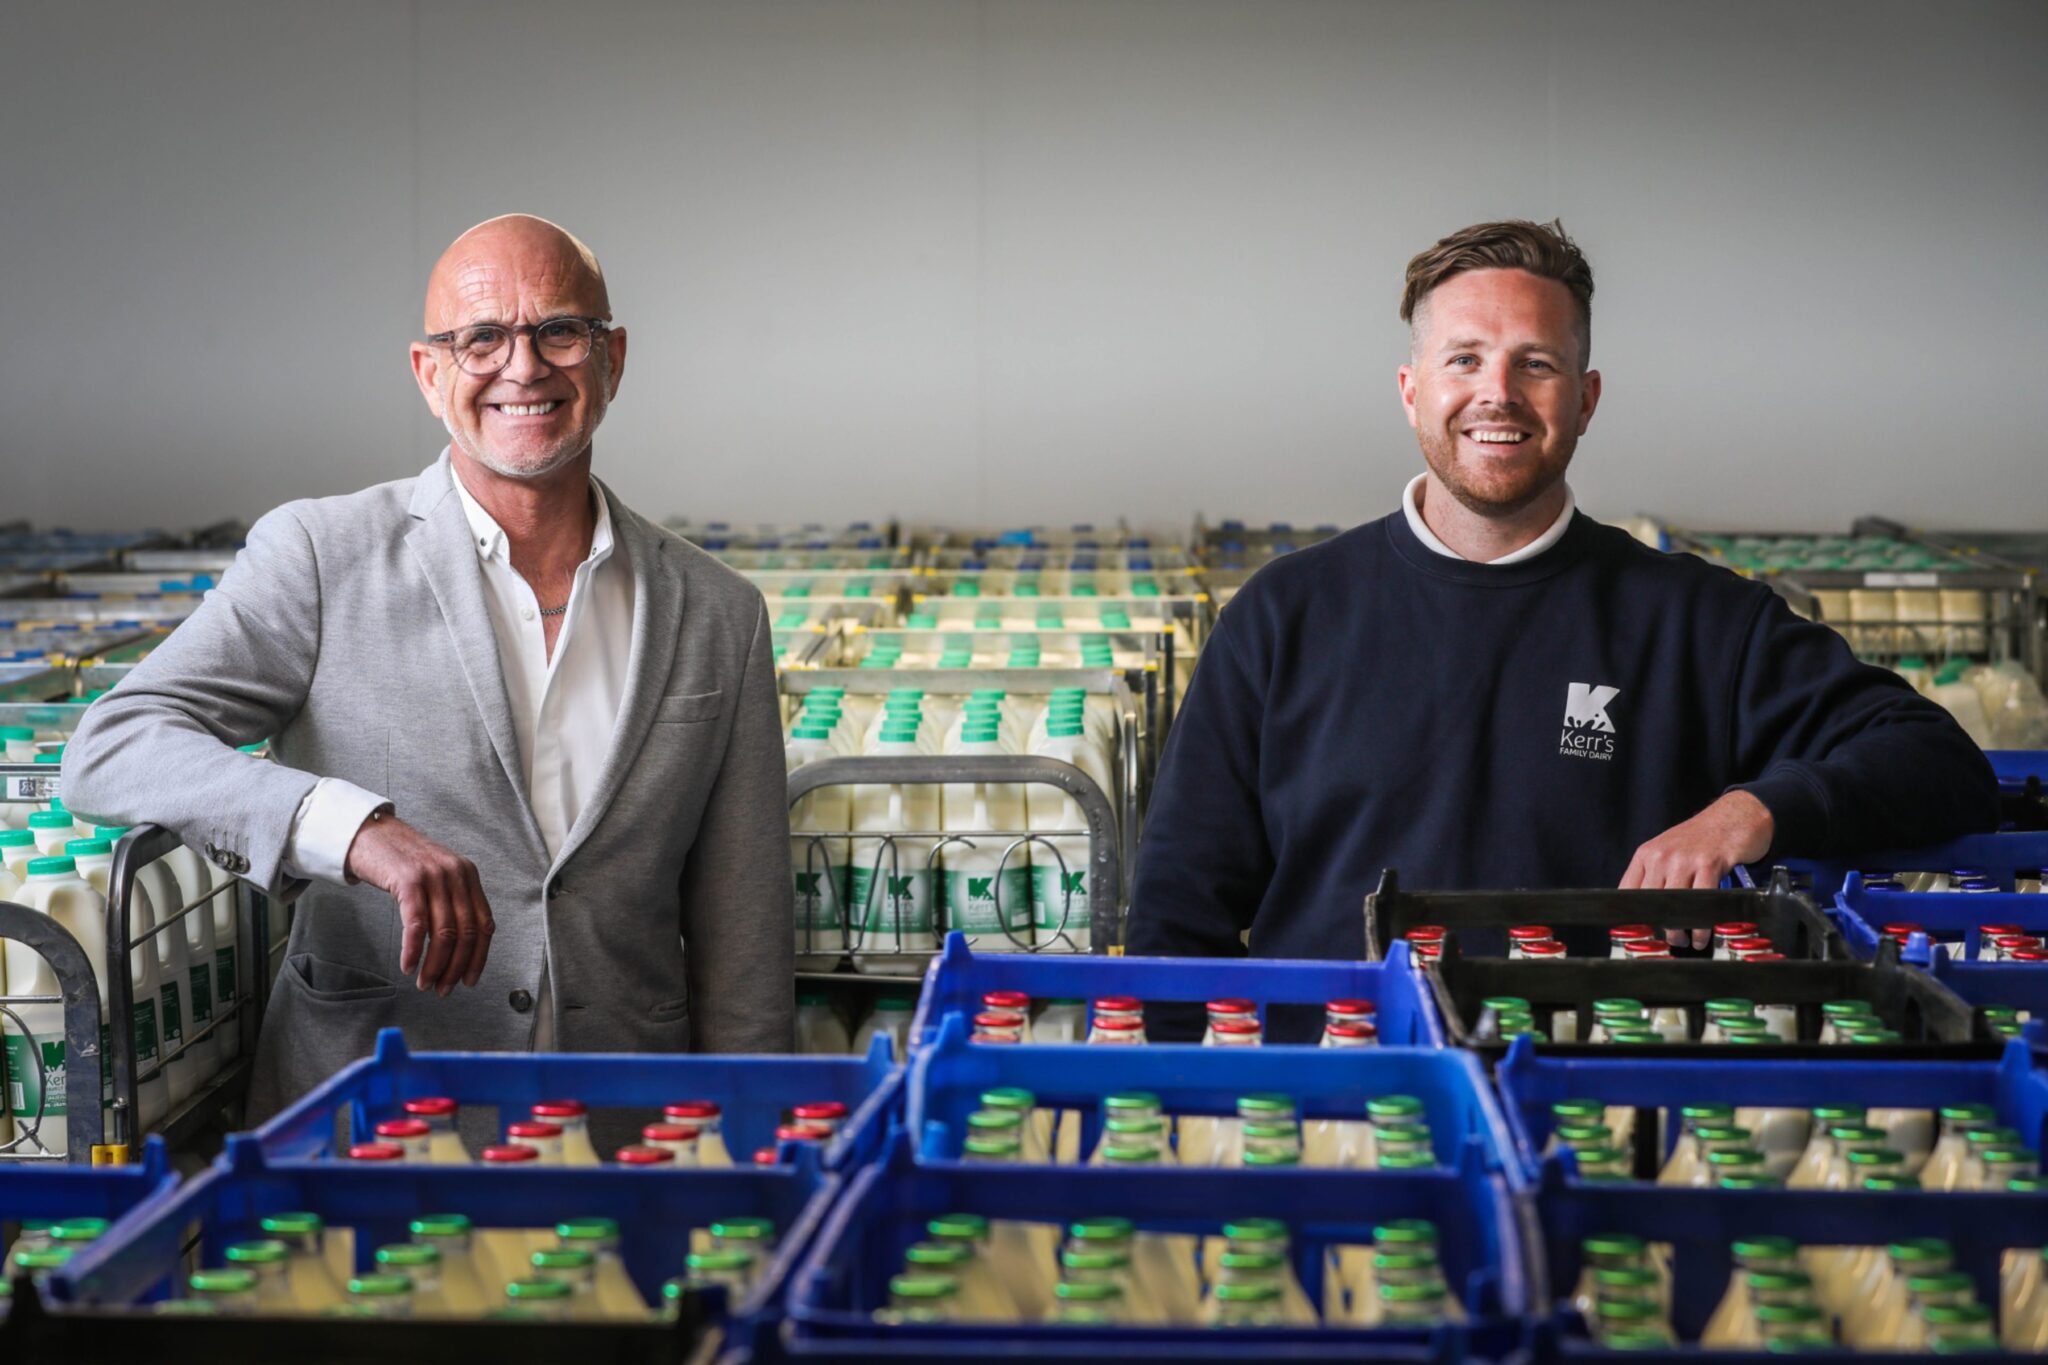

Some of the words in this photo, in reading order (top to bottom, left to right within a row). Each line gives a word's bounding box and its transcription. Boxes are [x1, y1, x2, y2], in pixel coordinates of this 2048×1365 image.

[1563, 682, 1620, 733] K
[1560, 729, 1615, 753] Kerr's
[1559, 747, 1588, 758] FAMILY
[1588, 751, 1613, 760] DAIRY
[888, 876, 914, 899] K
[968, 877, 994, 900] K
[1061, 871, 1087, 895] K
